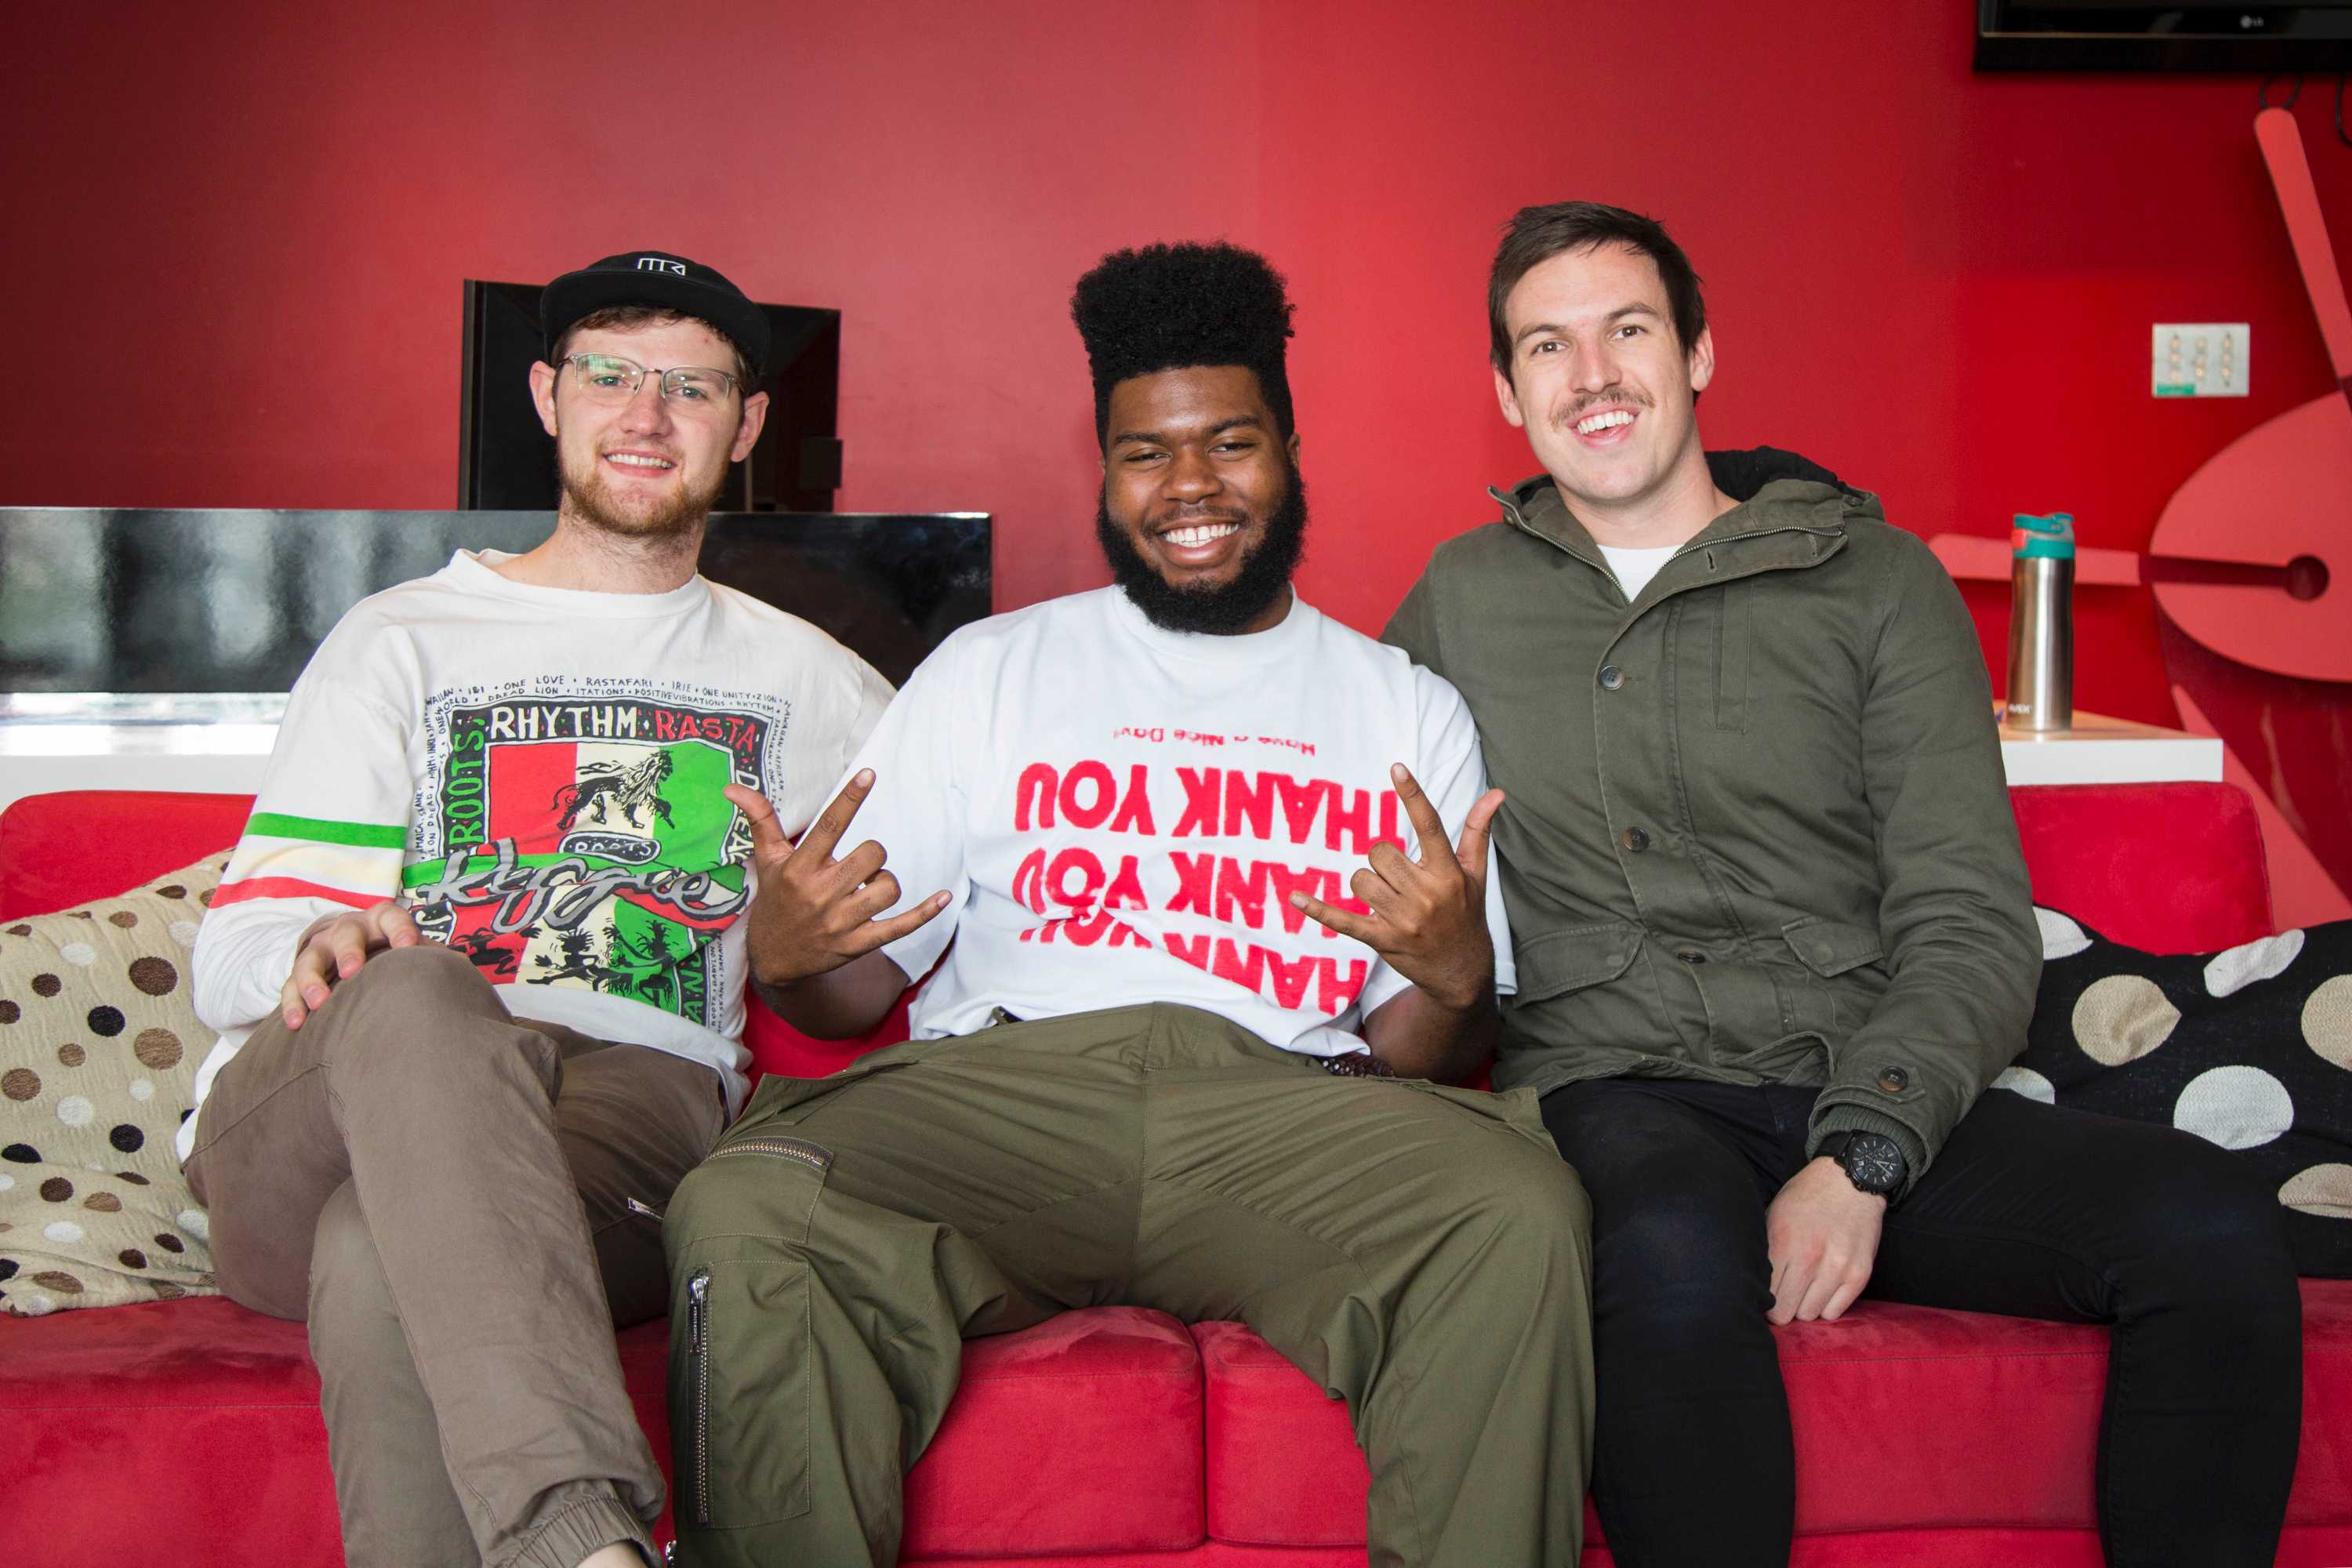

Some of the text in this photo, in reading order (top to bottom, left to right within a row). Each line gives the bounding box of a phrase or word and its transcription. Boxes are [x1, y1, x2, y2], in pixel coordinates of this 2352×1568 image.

[504, 679, 526, 690] ONE
[536, 675, 564, 684] LOVE
[586, 677, 653, 688] RASTAFARI
[672, 680, 691, 691] IRIE
[702, 687, 719, 697] ONE
[722, 691, 752, 700] UNITY
[757, 693, 777, 703] ZION
[535, 686, 559, 695] LION
[490, 706, 638, 739] RHYTHM
[655, 710, 757, 753] RASTA
[1173, 729, 1225, 746] Nice
[1014, 760, 1406, 855] THANK YOU
[1012, 848, 1374, 938] HANK YOU
[1163, 933, 1368, 1017] HANK
